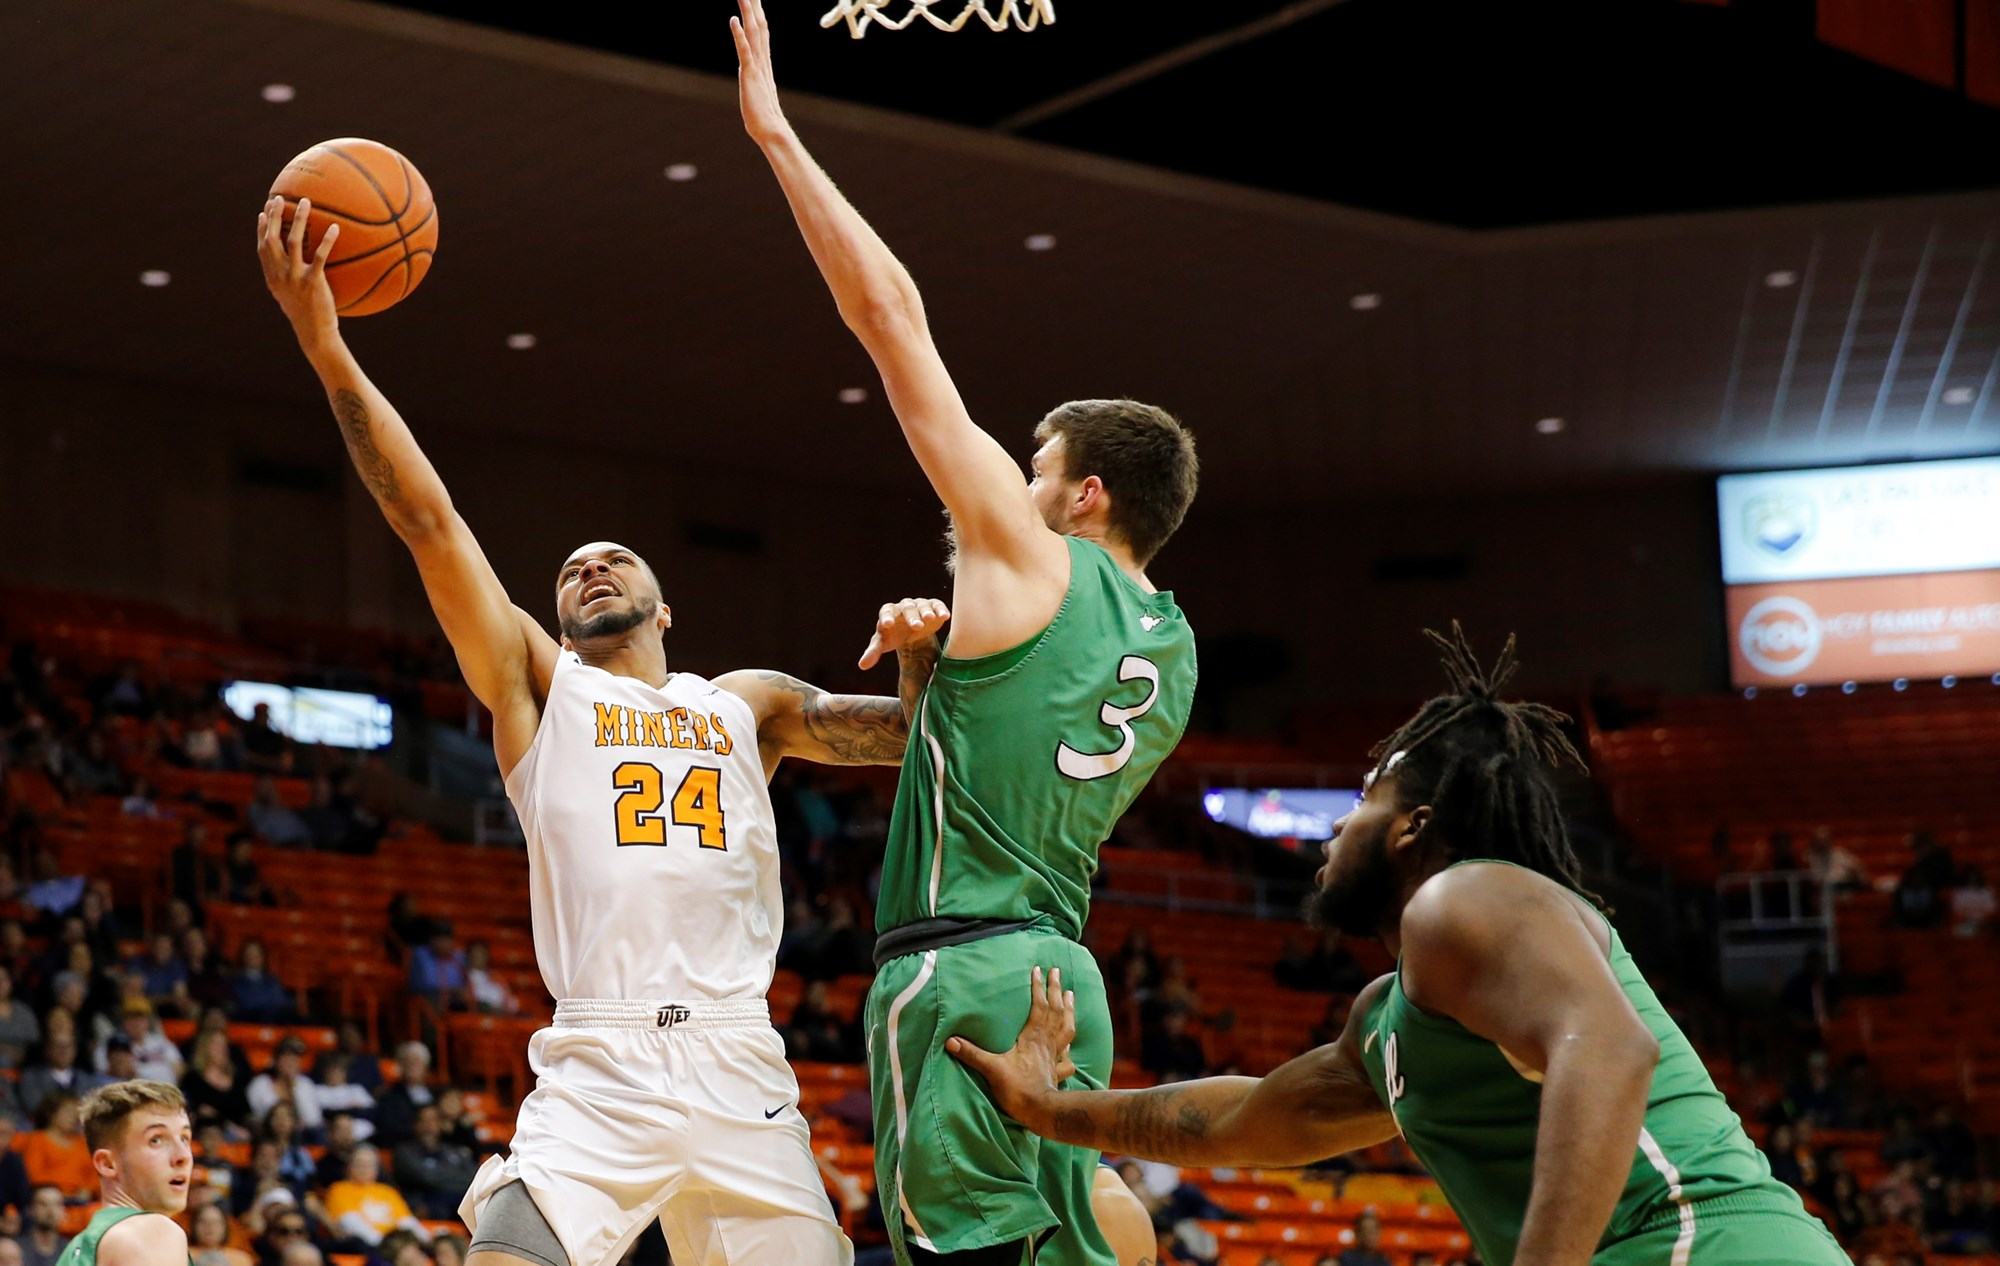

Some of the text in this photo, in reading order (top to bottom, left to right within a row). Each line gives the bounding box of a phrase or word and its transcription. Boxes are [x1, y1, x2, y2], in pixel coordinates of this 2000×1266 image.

[594, 702, 733, 755] MINERS
[1054, 654, 1159, 781] 3
[612, 762, 728, 852] 24
[656, 1003, 691, 1028] UTEP
